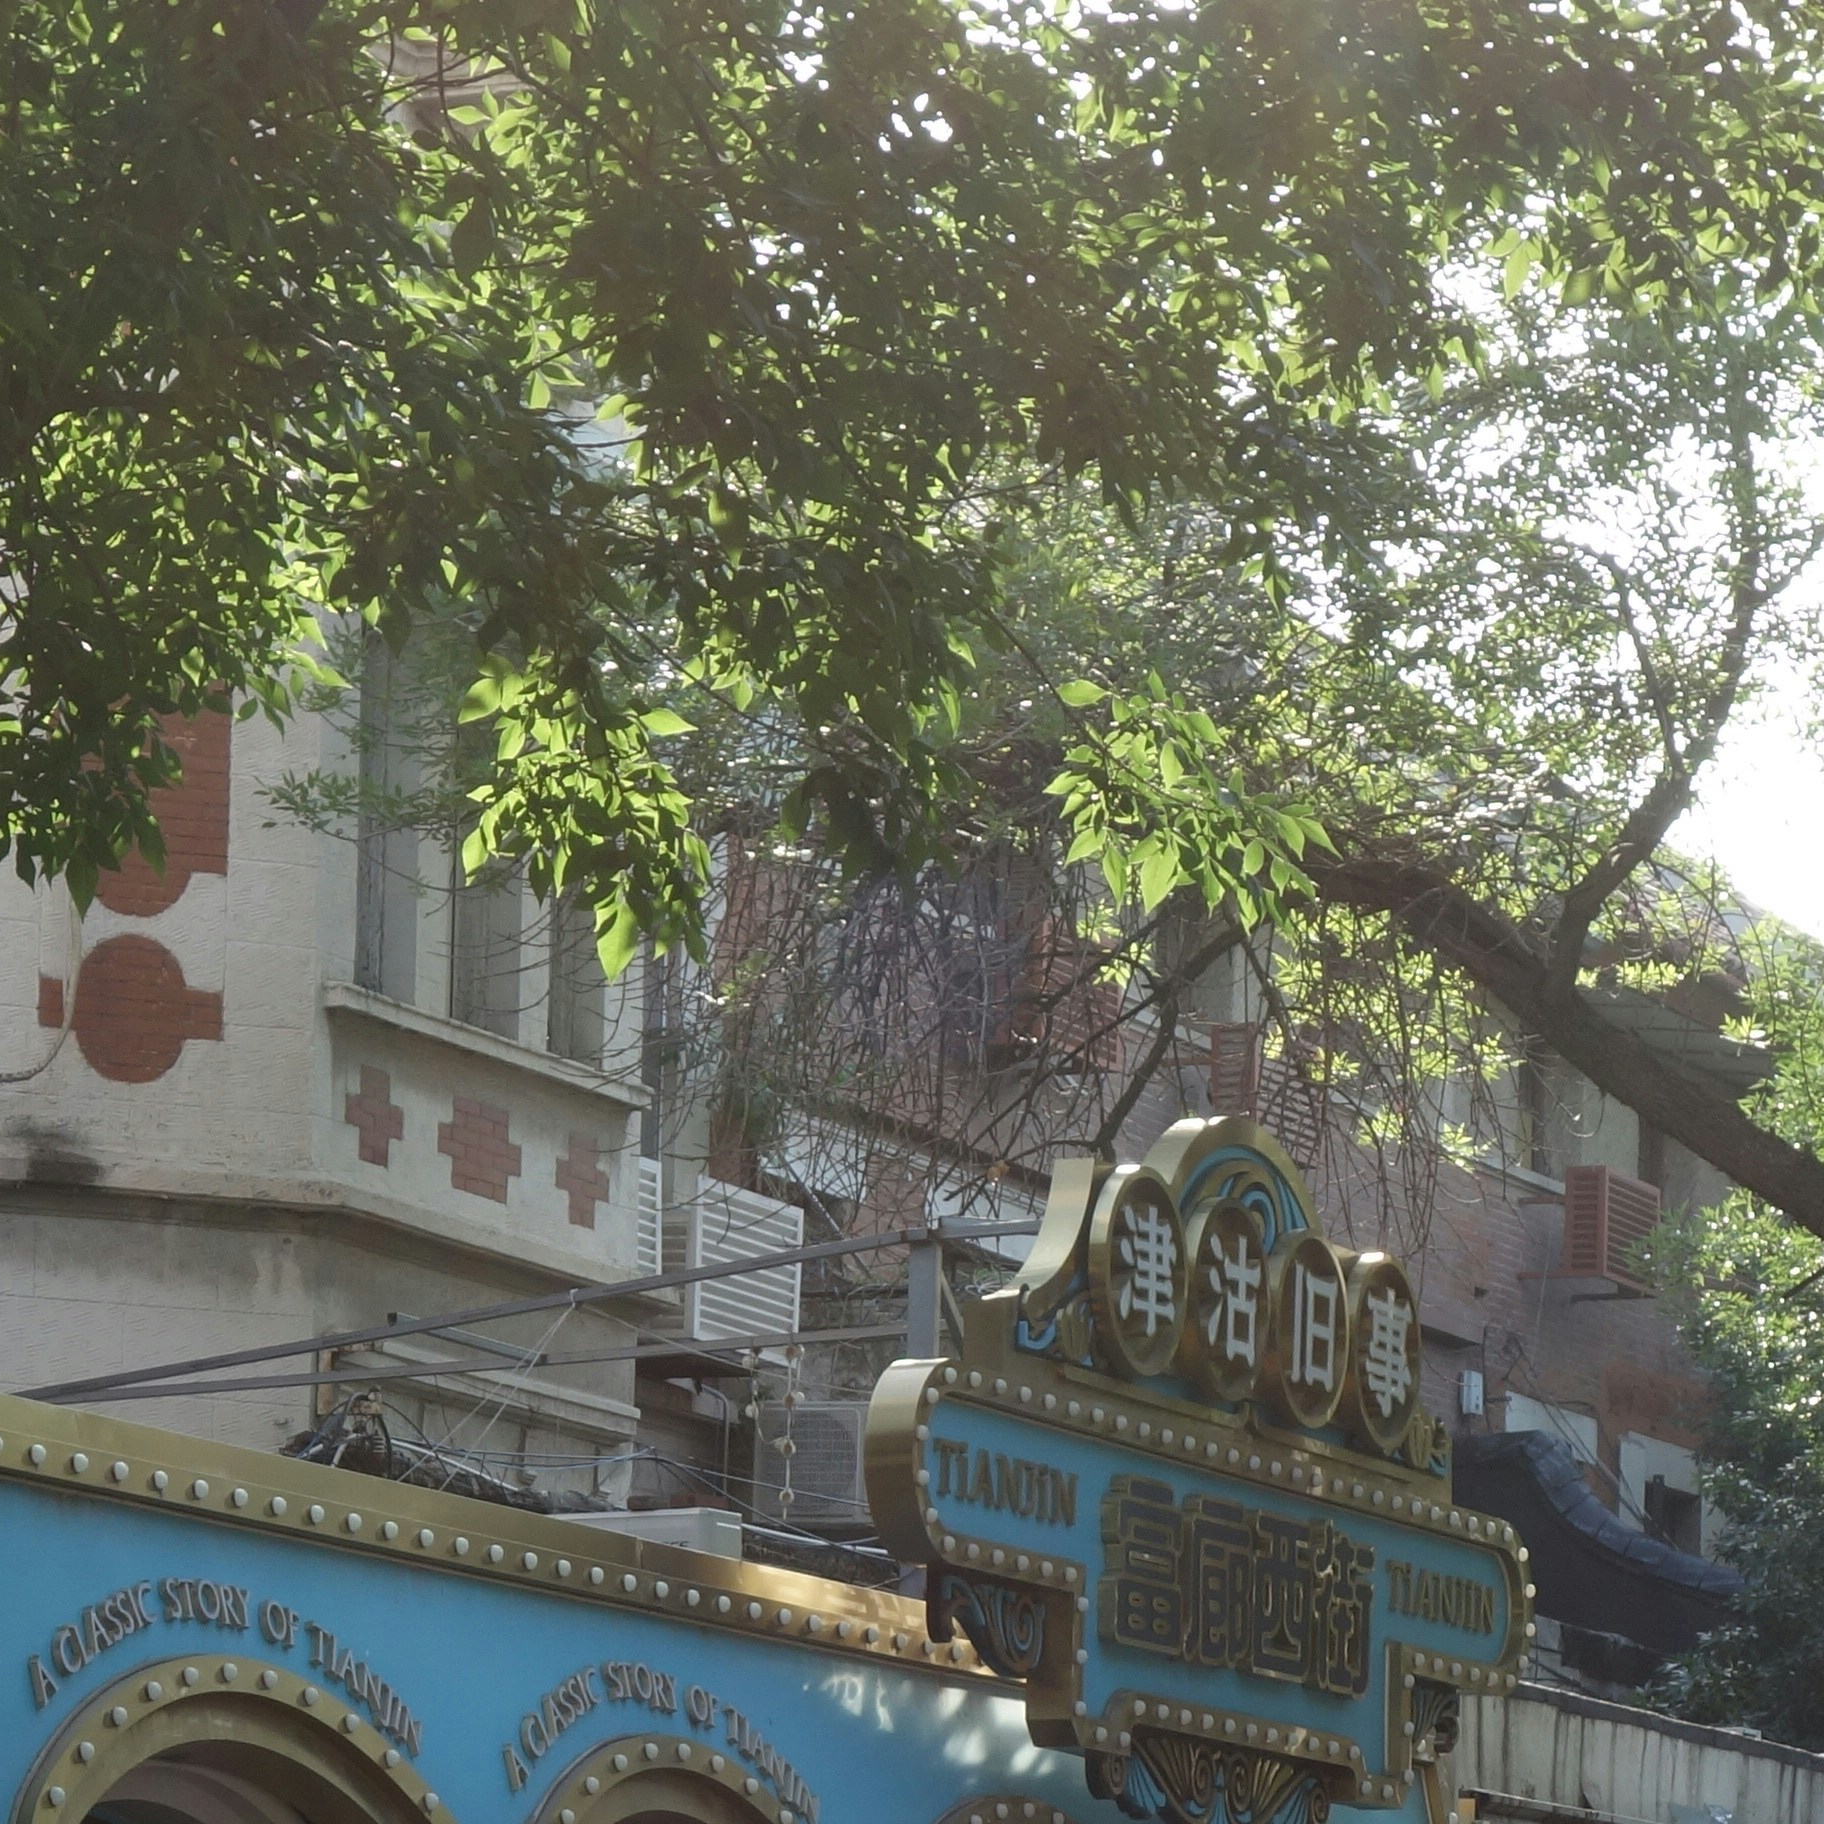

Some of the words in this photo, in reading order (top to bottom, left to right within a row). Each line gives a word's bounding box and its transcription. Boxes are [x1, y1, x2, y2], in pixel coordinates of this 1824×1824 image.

[1118, 1203, 1414, 1420] 津沽旧事
[28, 1655, 59, 1710] A
[52, 1580, 157, 1676] CLASSIC
[158, 1577, 250, 1629] STORY
[260, 1600, 299, 1650] OF
[306, 1620, 422, 1758] TIANJIN
[503, 1743, 530, 1792] A
[520, 1665, 599, 1759] CLASSIC
[601, 1660, 677, 1715] STORY
[684, 1684, 719, 1729] OF
